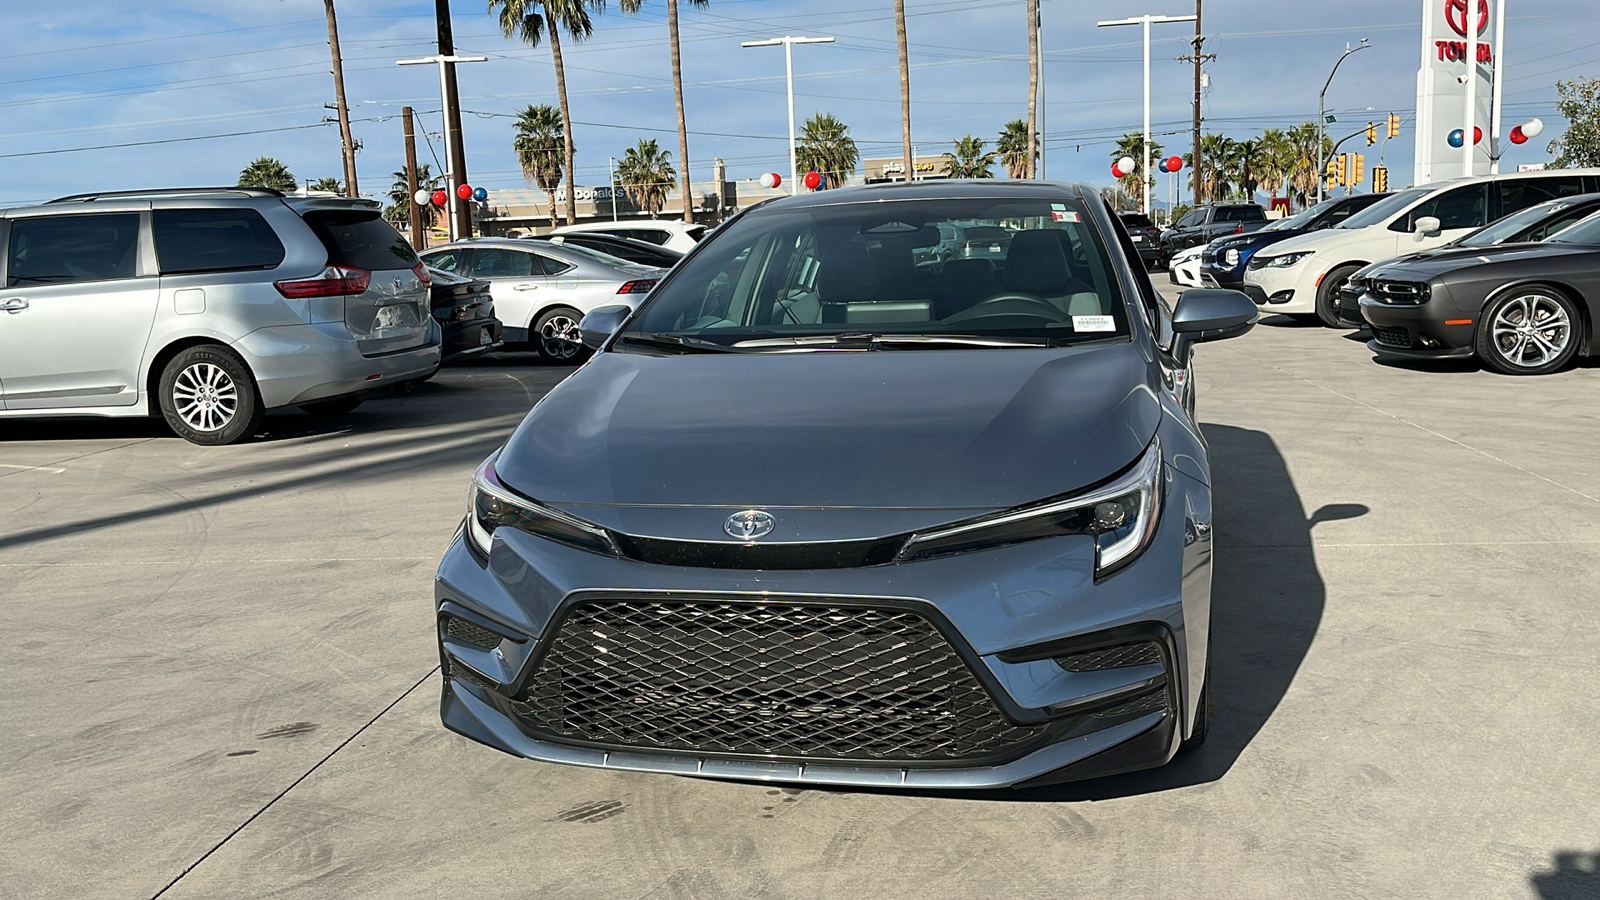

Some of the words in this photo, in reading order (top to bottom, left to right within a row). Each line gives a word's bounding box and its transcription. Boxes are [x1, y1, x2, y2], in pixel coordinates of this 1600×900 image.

[1435, 41, 1492, 61] TOYTA
[912, 161, 934, 171] lace
[557, 188, 625, 201] MDonald's
